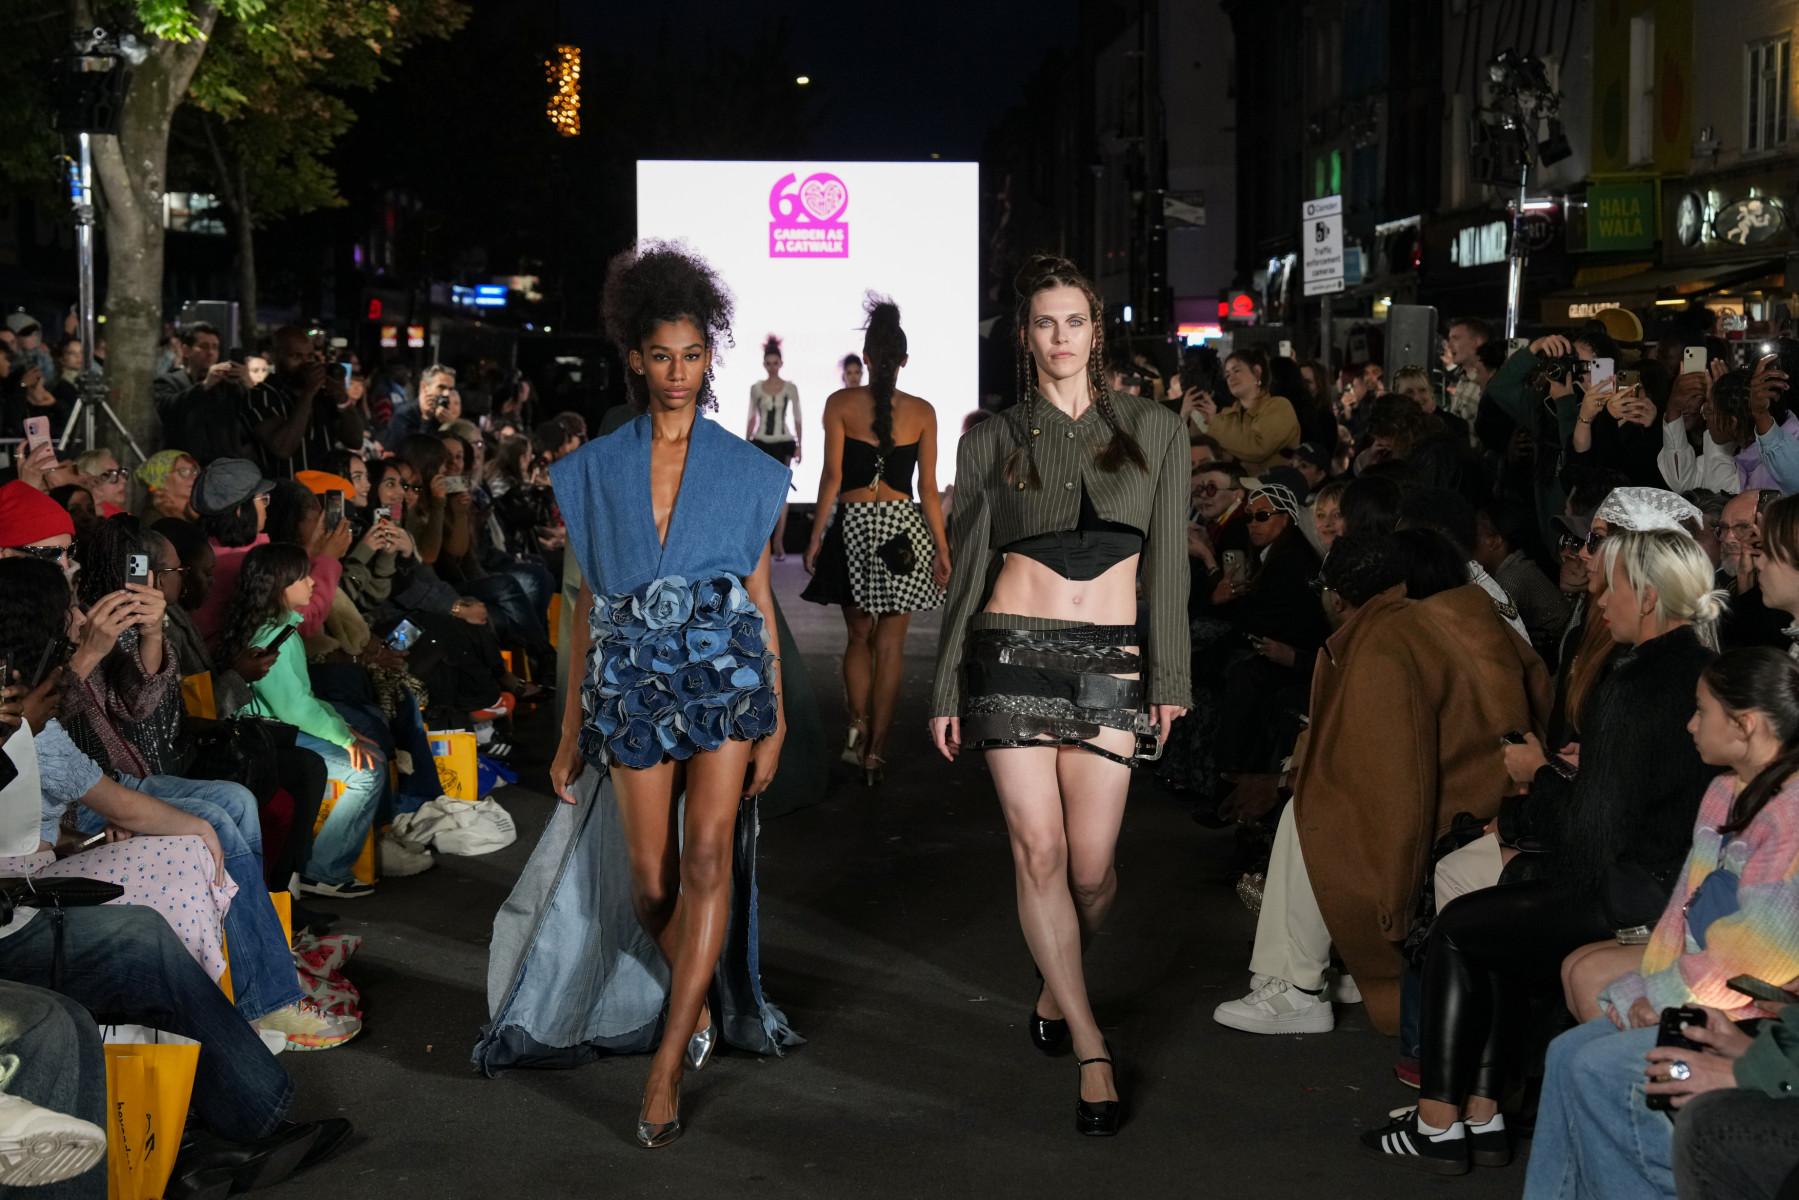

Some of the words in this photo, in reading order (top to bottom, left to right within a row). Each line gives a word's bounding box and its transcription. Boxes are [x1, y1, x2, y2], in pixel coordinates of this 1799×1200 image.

[1600, 198, 1640, 217] HALA
[1600, 218, 1643, 237] WALA
[774, 228, 825, 240] CAMDEN
[827, 228, 844, 240] AS
[775, 241, 785, 252] A
[786, 241, 843, 252] CATWALK
[1314, 246, 1332, 256] Traffic
[1312, 268, 1335, 277] cameras
